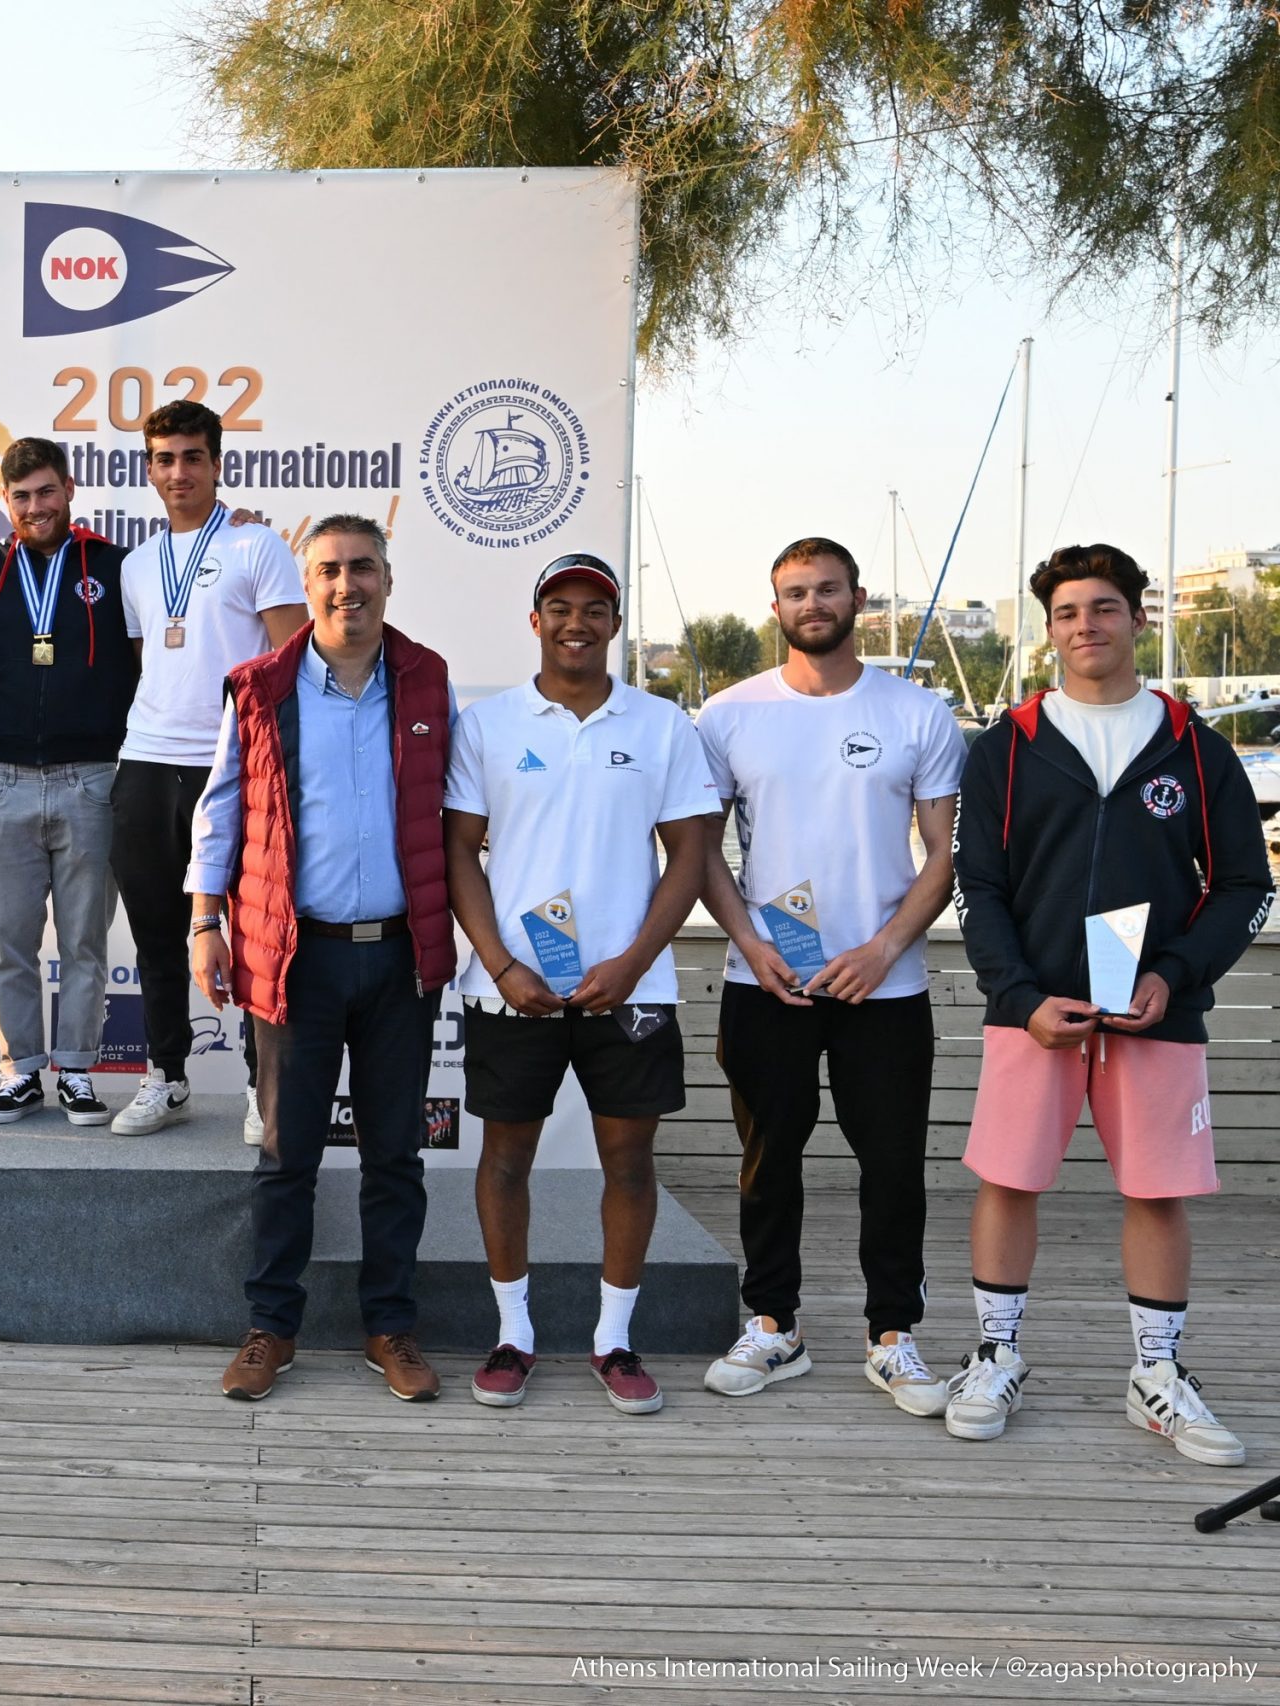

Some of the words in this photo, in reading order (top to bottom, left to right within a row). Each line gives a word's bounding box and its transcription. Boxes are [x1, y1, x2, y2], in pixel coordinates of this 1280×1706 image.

[51, 257, 118, 280] NOK
[419, 401, 455, 464] ΕΛΛΗΝΙΚΗ
[541, 388, 591, 465] ΟΜΟΣΠΟΝΔΙΑ
[422, 485, 466, 537] HELLENIC
[466, 532, 520, 549] SAILING
[523, 486, 586, 546] FEDERATION
